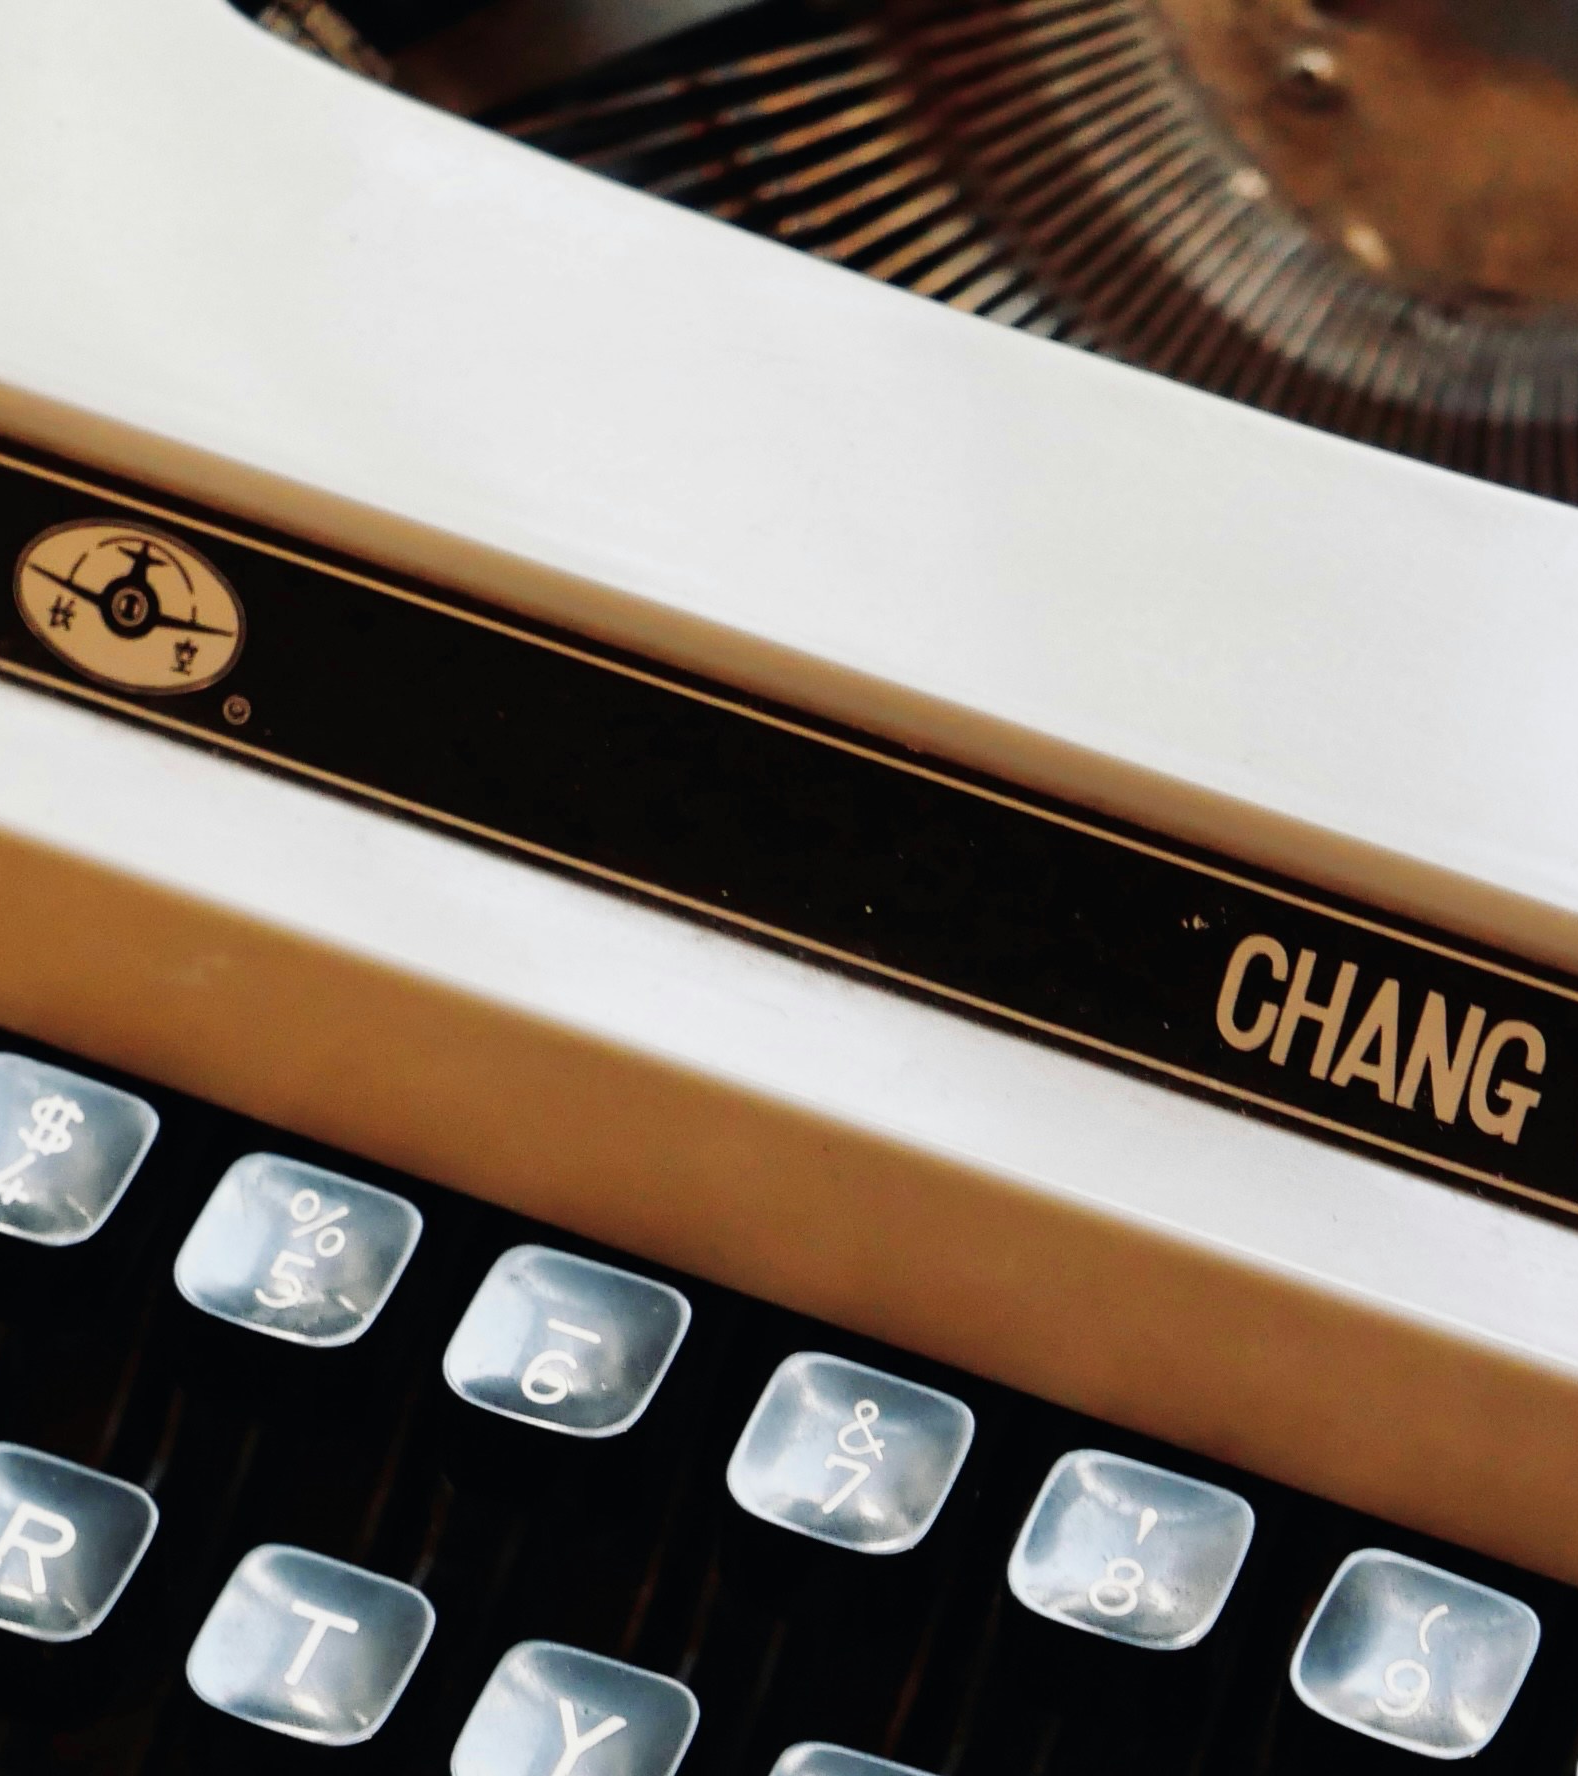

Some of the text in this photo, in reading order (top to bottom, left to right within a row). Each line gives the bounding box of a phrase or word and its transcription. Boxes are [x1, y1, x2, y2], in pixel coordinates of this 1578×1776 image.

[1216, 932, 1547, 1146] CHANG
[18, 1095, 85, 1156] $
[290, 1189, 350, 1258] %
[255, 1251, 315, 1309] 5
[521, 1349, 578, 1405] 6
[837, 1399, 885, 1461] &
[823, 1455, 871, 1514] 7
[1089, 1557, 1144, 1616] 8
[284, 1599, 359, 1686] T
[1420, 1604, 1449, 1654] (
[1375, 1659, 1431, 1718] 9
